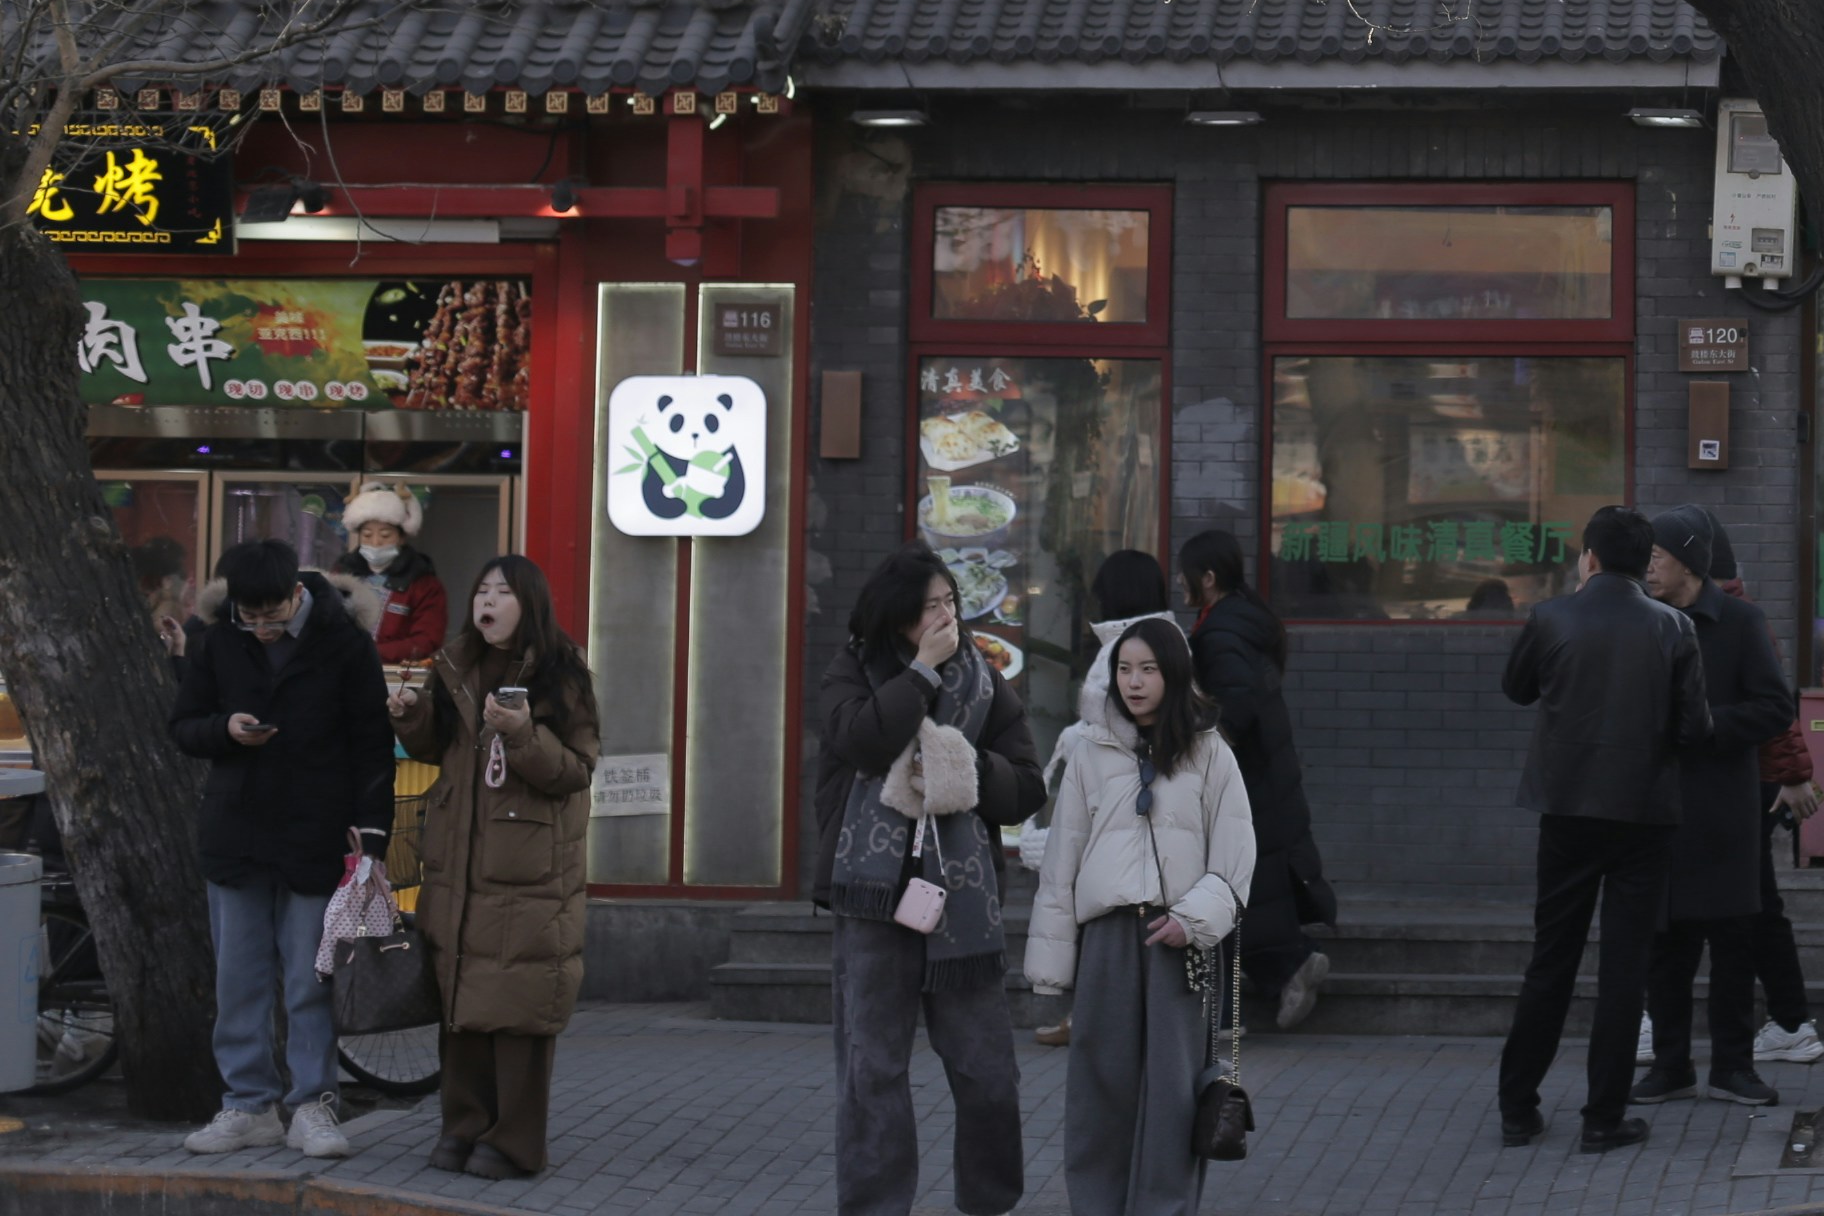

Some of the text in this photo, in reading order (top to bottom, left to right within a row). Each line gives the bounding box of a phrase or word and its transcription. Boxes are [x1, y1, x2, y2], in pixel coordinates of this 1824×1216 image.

[740, 311, 771, 328] 116
[78, 301, 236, 391] 肉串
[1706, 327, 1738, 344] 120
[920, 366, 1012, 394] 清真美食
[1279, 519, 1575, 566] 新疆风味清真餐厅
